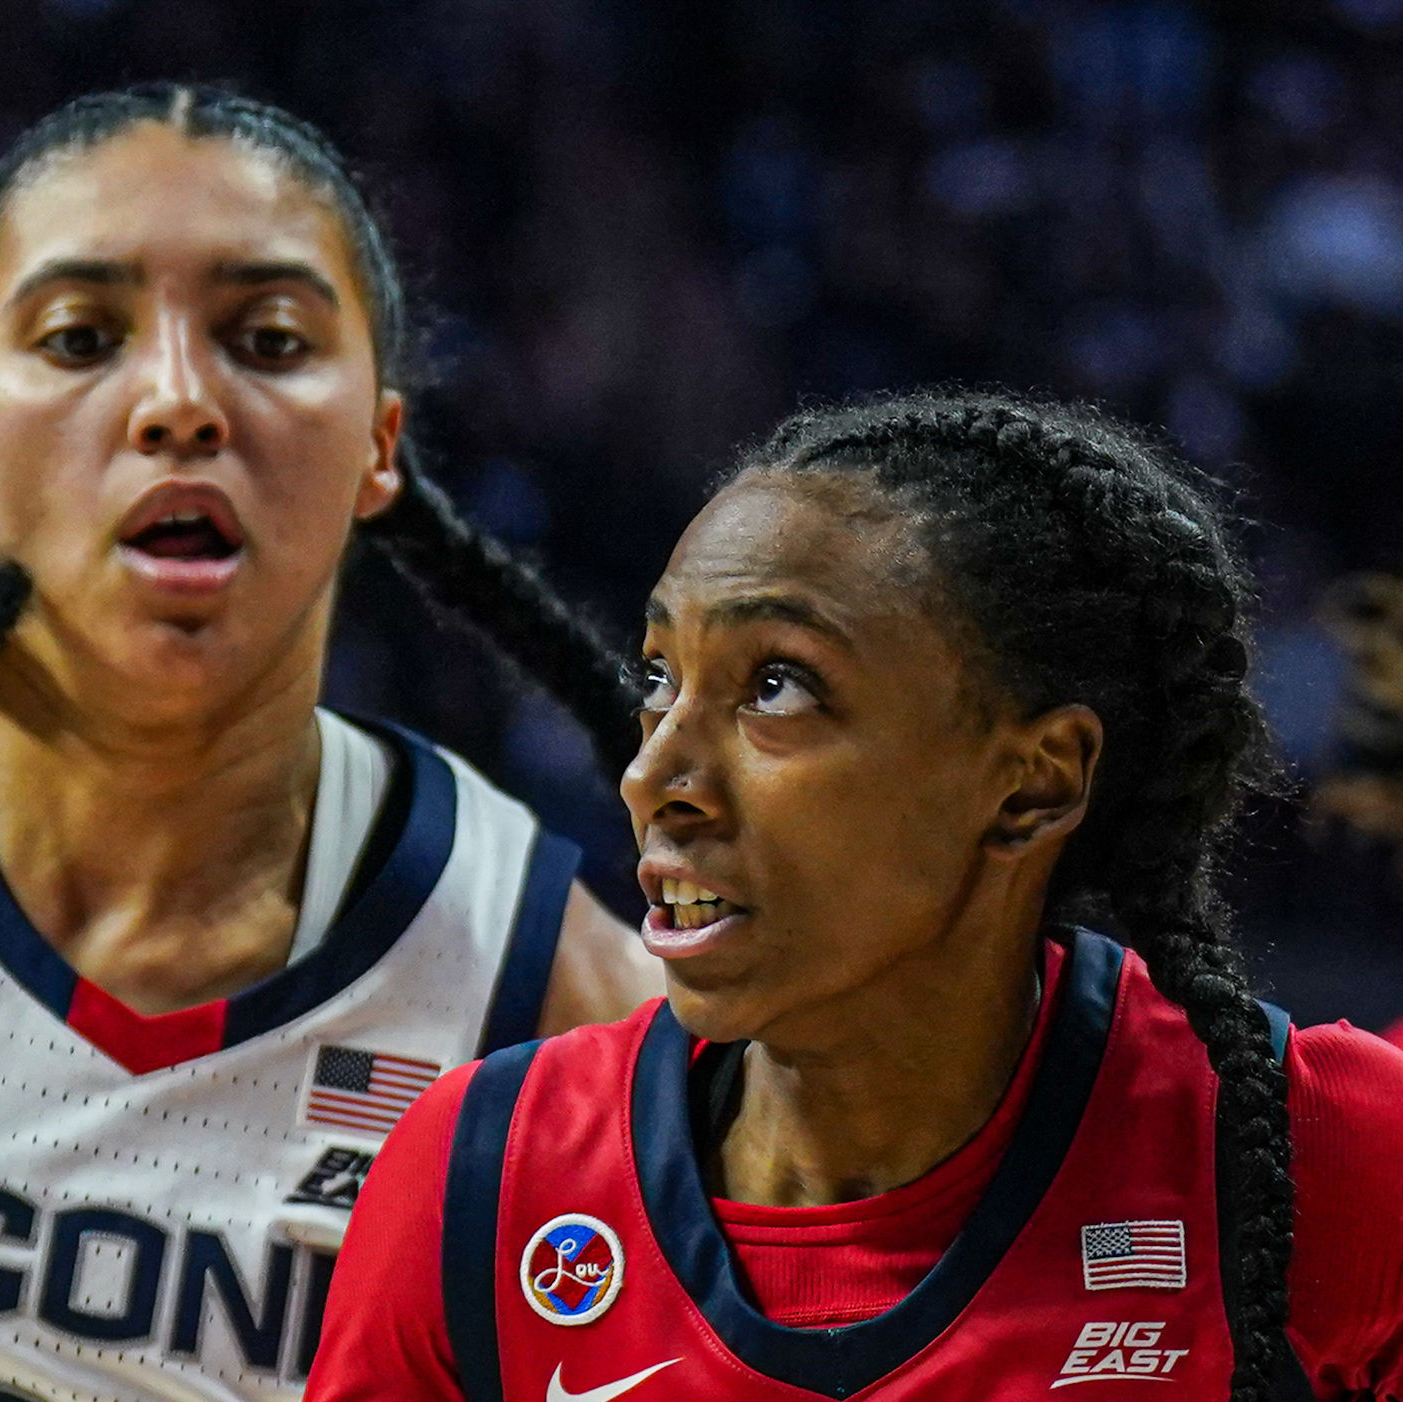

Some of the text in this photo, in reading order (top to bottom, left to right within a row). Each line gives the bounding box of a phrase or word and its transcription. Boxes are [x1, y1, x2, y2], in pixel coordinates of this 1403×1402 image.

[534, 1237, 611, 1293] Lou
[1073, 1321, 1167, 1348] BIG
[1059, 1348, 1190, 1374] EAST
